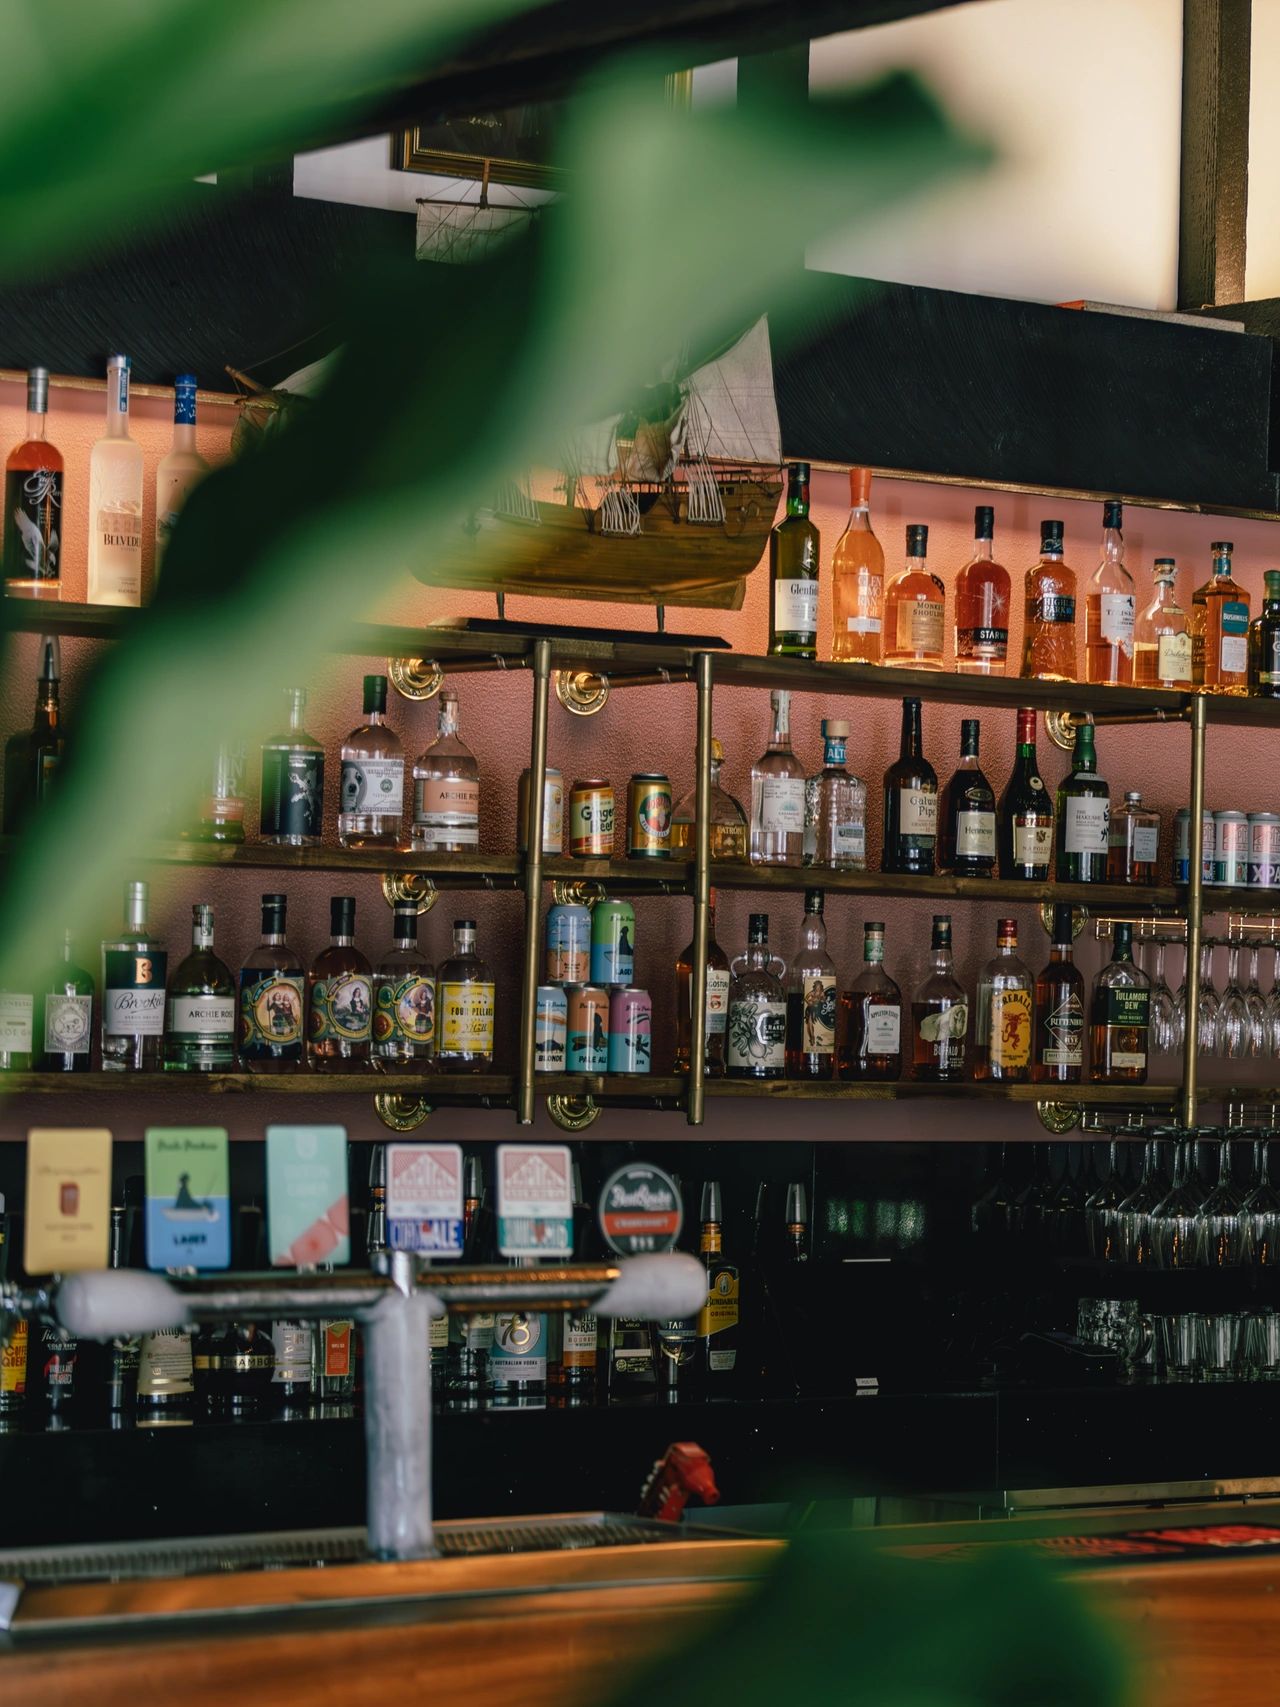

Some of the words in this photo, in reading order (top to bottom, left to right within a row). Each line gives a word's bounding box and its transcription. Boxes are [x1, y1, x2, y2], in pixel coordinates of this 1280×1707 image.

[1223, 614, 1248, 623] BUSHMILLS
[440, 792, 467, 800] ARCHIE
[1252, 864, 1280, 882] XPA
[1115, 990, 1148, 1001] TULLAMORE
[1124, 1001, 1139, 1009] DEW
[538, 1055, 562, 1063] BLONDE
